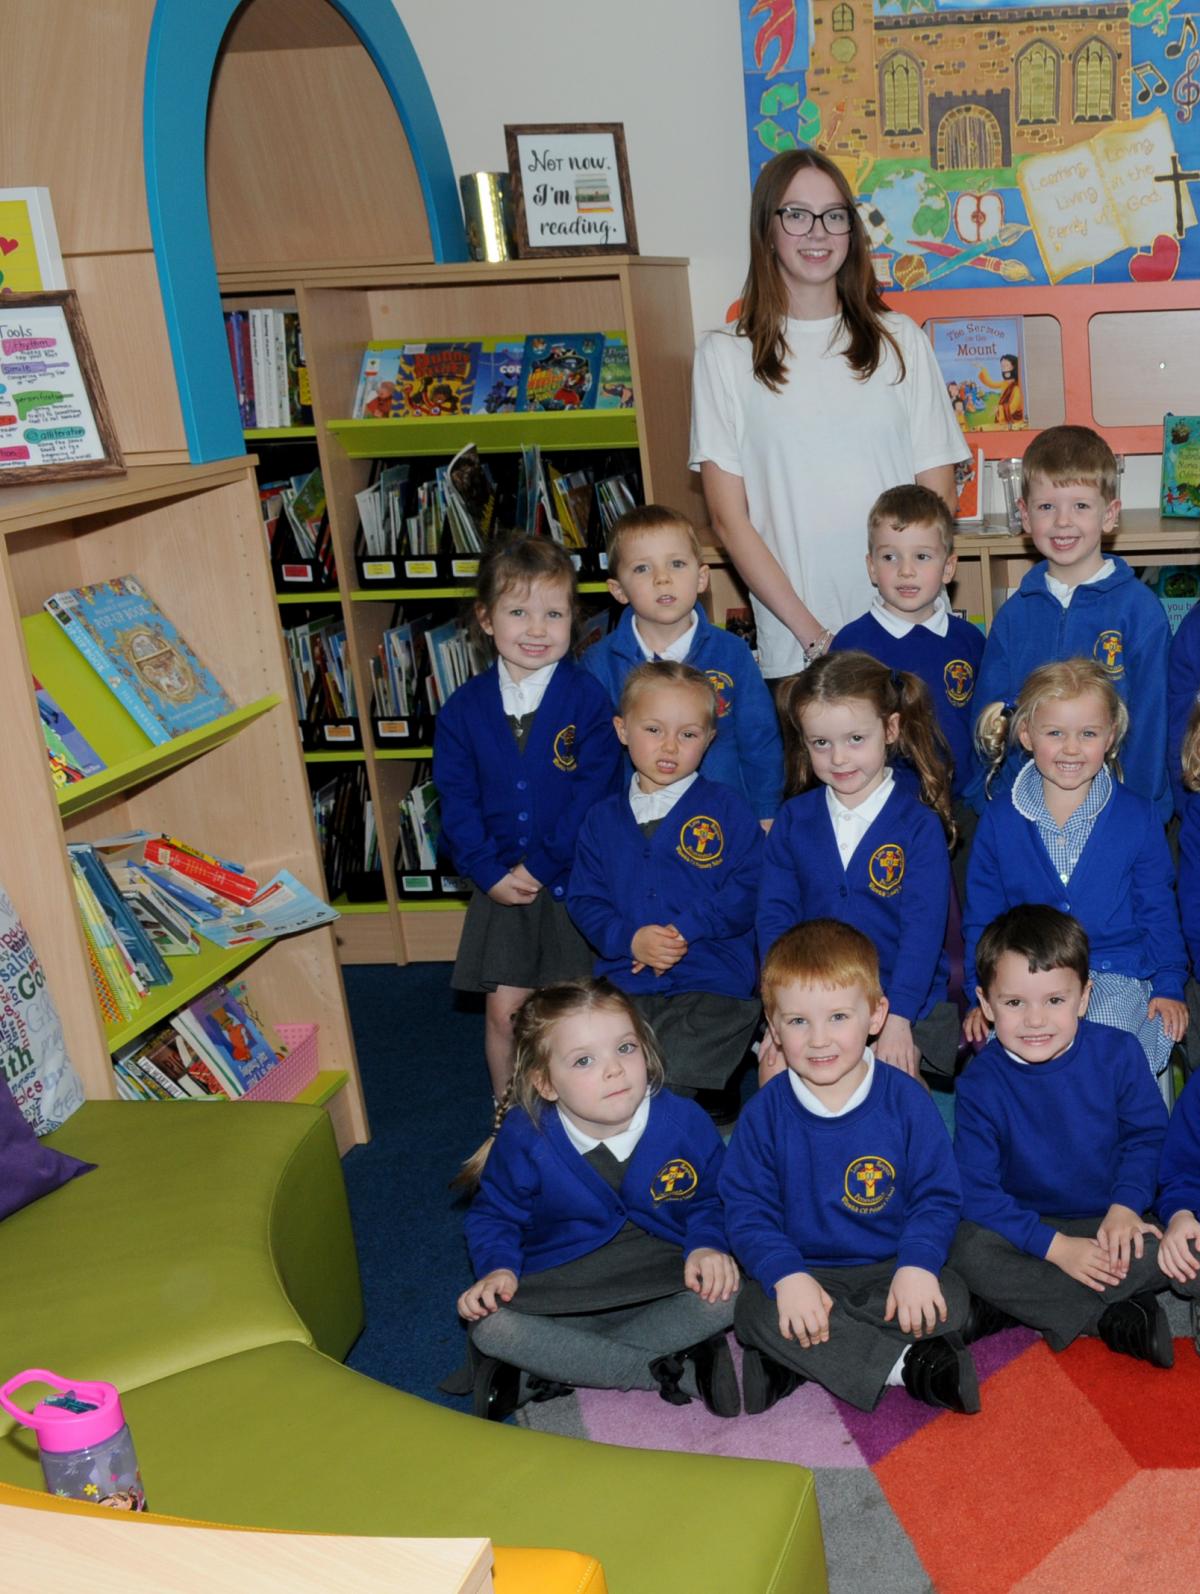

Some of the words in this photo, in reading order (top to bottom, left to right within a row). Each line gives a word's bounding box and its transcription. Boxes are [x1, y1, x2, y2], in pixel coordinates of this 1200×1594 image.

[533, 184, 570, 206] I'm
[0, 324, 33, 339] Tools
[946, 329, 966, 341] The
[966, 323, 1005, 338] Sermon
[957, 344, 997, 356] Mount
